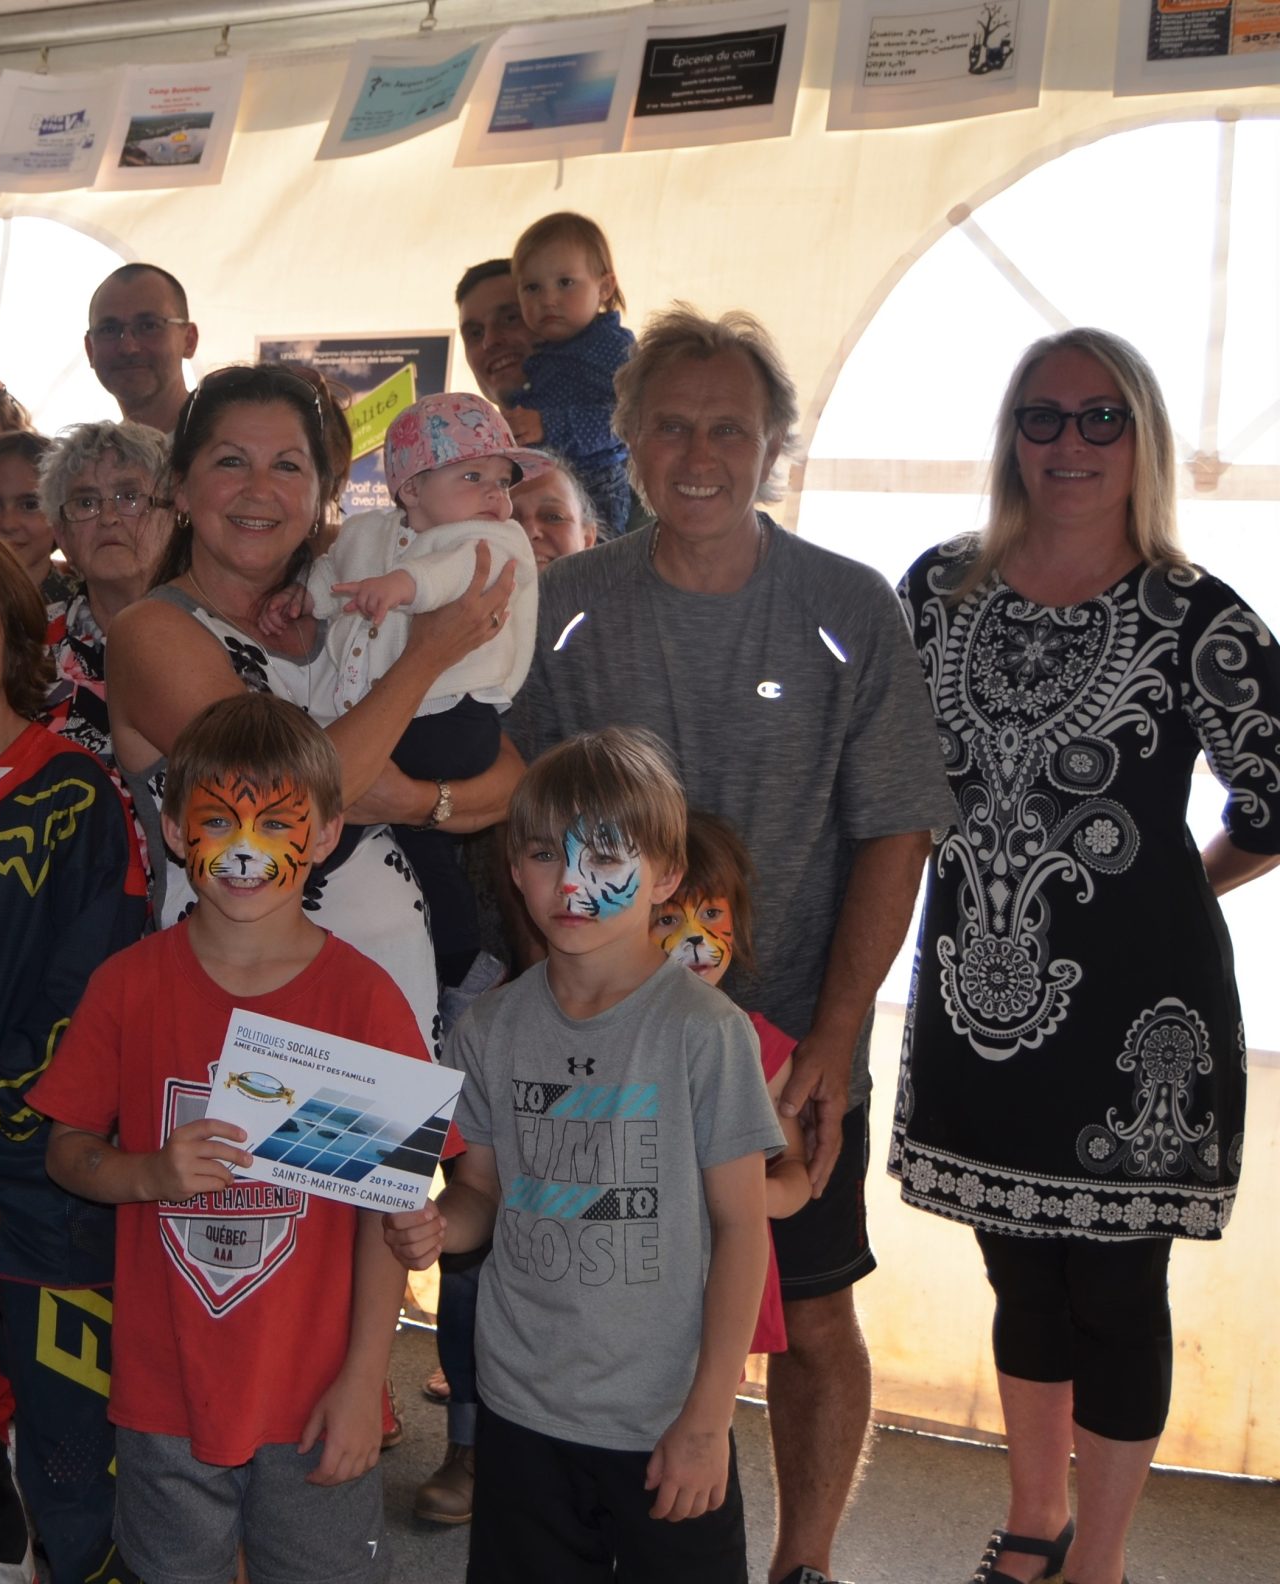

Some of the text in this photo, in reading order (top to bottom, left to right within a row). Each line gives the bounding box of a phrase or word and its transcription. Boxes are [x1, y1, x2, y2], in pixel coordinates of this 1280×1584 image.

[672, 48, 756, 68] Épicerie du coin
[380, 355, 404, 363] enfants
[346, 481, 371, 493] Droit
[352, 492, 390, 506] avec les
[236, 1025, 331, 1061] POLITIQUES SOCIALES
[233, 1040, 376, 1085] AMIE DES AÎNÉS (MADA) ET DES FAMILLES
[512, 1081, 545, 1111] NO
[514, 1115, 658, 1185] TIME
[271, 1167, 416, 1210] SAINTS-MARTYRS-CANADIENS
[369, 1176, 420, 1194] 2019-2021
[616, 1190, 657, 1218] TO
[205, 1225, 248, 1246] QUÉBEC
[504, 1208, 660, 1286] LOSE
[213, 1247, 233, 1262] AAA
